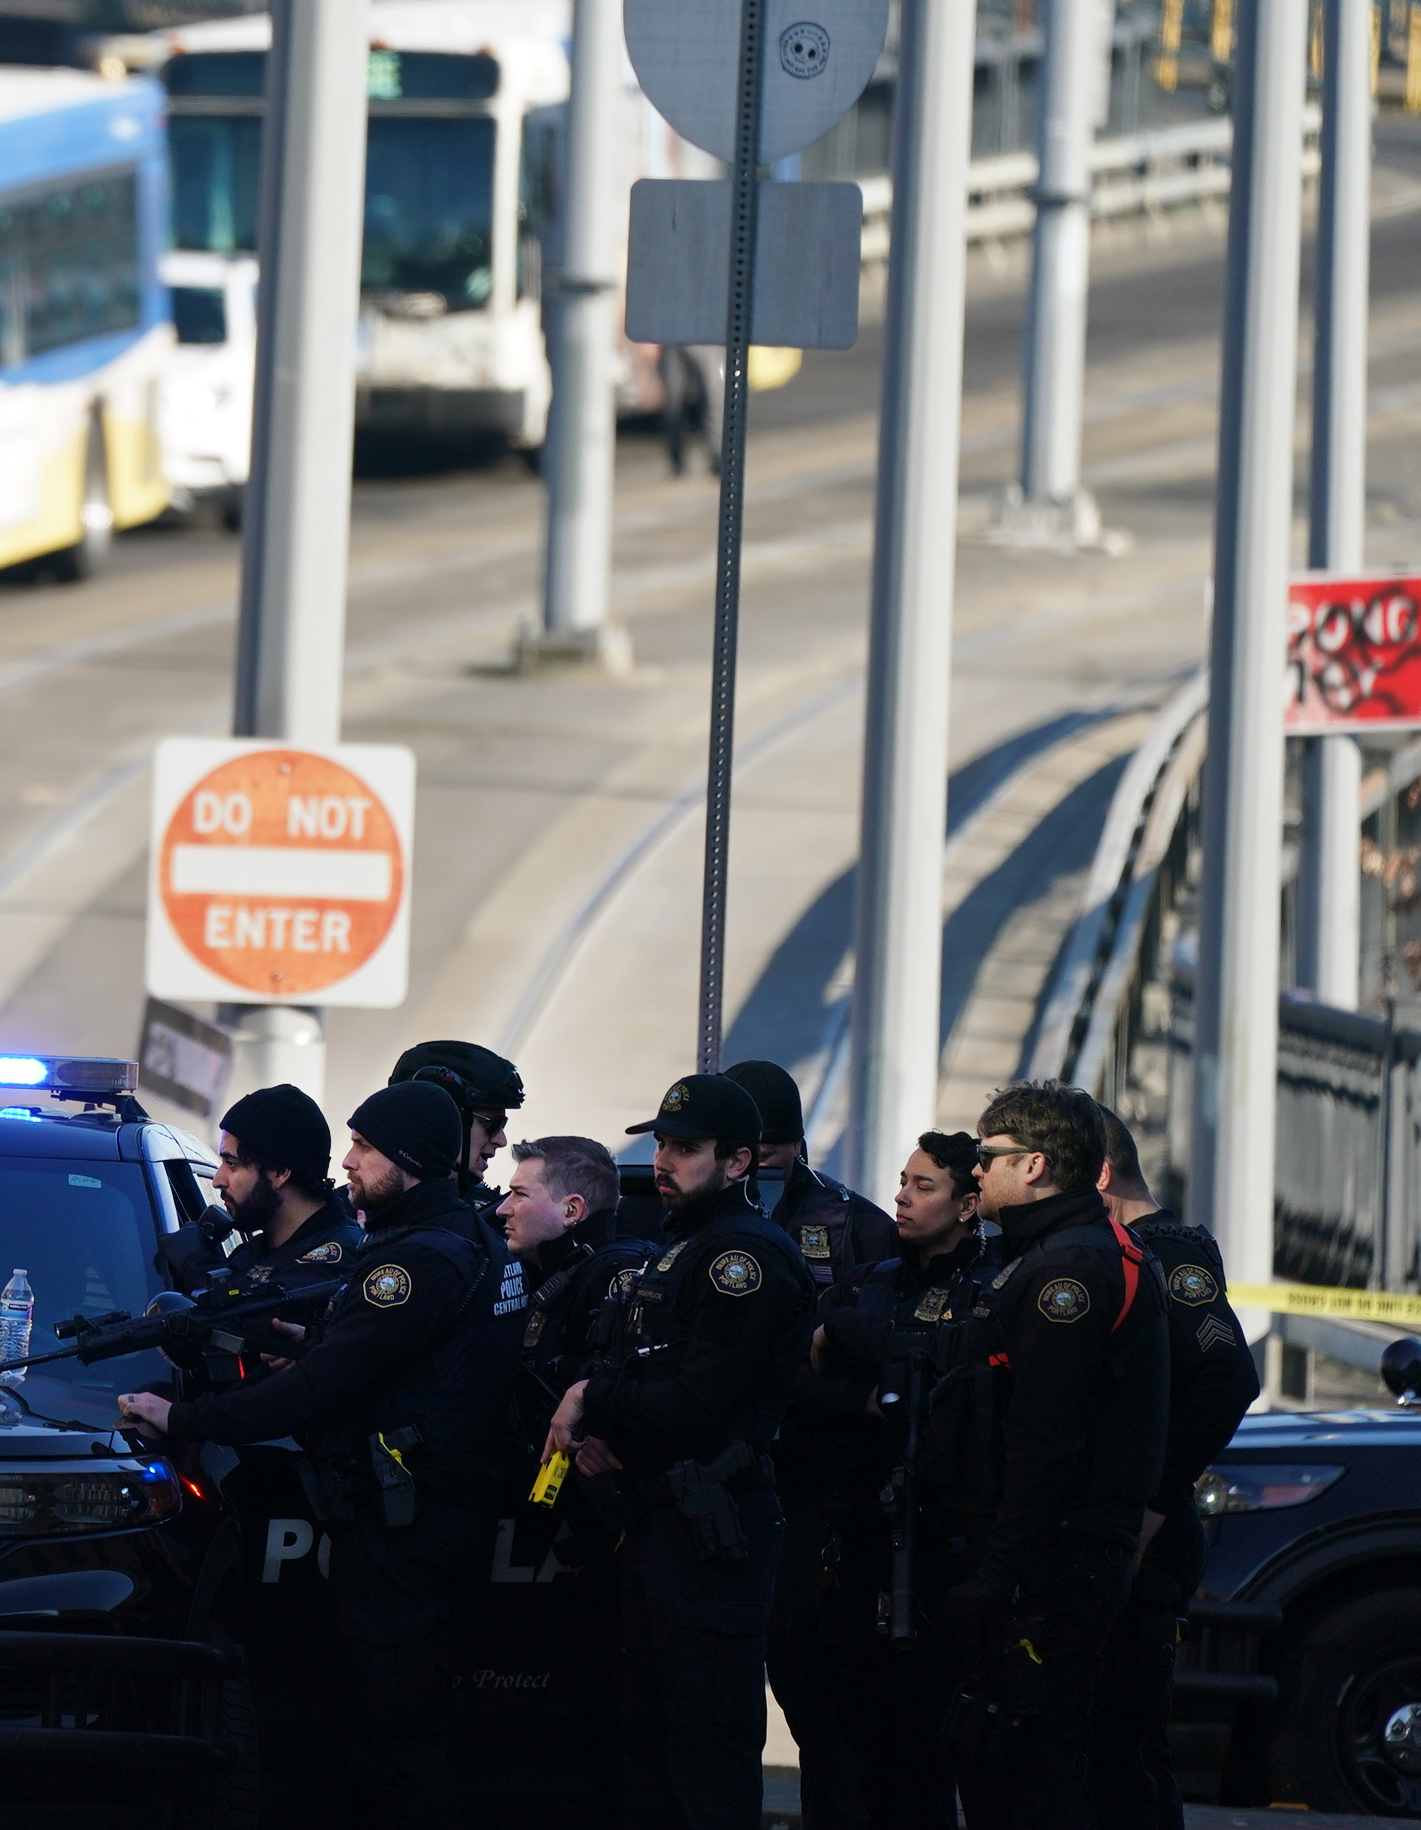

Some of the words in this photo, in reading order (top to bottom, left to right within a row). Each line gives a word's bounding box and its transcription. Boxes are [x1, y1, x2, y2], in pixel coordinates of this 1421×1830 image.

[193, 791, 252, 834] DO
[287, 795, 371, 839] NOT
[204, 906, 352, 953] ENTER
[716, 1254, 739, 1270] BUREAU
[739, 1256, 748, 1265] OF
[746, 1260, 757, 1281] POLICE
[394, 1269, 401, 1277] OF
[398, 1274, 407, 1295] POLICE
[500, 1276, 524, 1299] POLICE
[718, 1275, 748, 1289] PORTLAND
[1173, 1268, 1187, 1291] BUREAU
[1186, 1267, 1194, 1275] OF
[369, 1286, 395, 1301] PORTLAND
[1042, 1282, 1063, 1301] BUREAU
[1070, 1284, 1085, 1303] POLICE
[1184, 1287, 1212, 1299] PORTLAND
[494, 1297, 521, 1316] CENTRAL
[1047, 1305, 1078, 1316] PORTLAND
[472, 1669, 553, 1690] Protect
